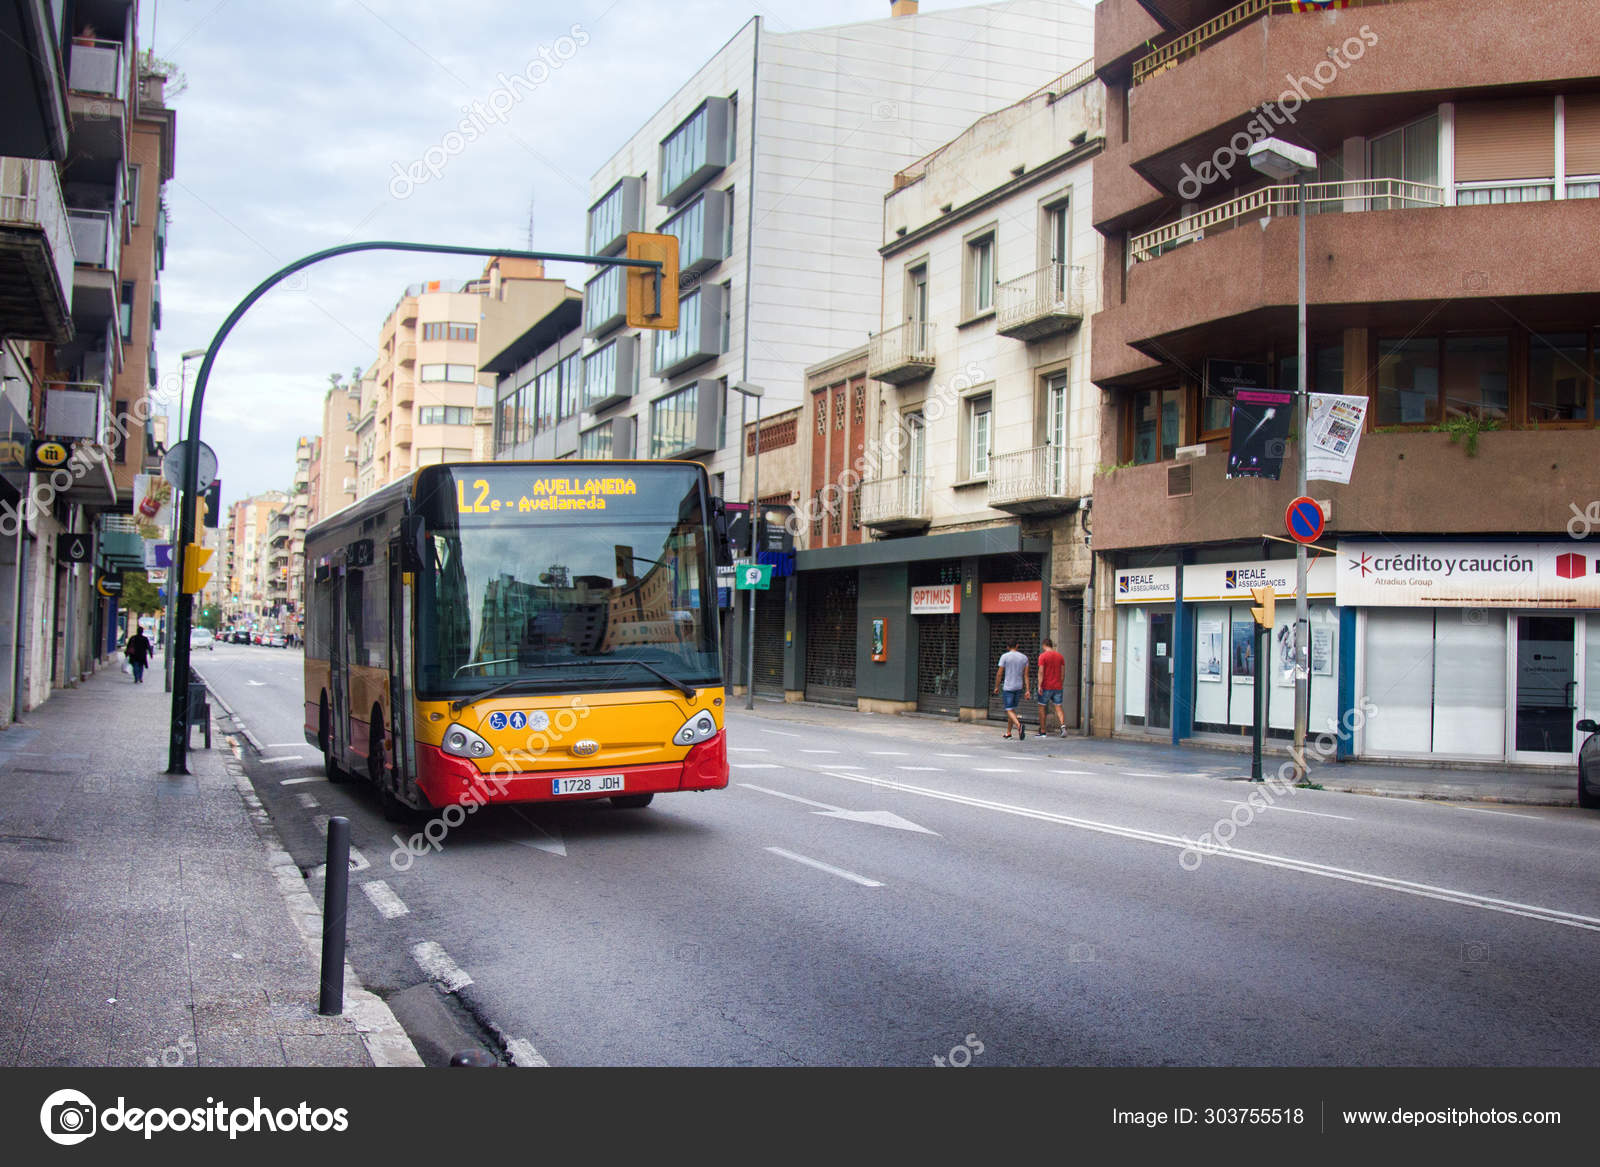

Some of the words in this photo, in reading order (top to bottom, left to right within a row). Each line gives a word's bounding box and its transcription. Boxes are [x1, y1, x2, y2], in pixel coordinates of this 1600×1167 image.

[533, 478, 637, 495] AVELLANEDA
[518, 495, 606, 512] Avellaneda
[1374, 554, 1442, 572] crédito
[1444, 558, 1456, 576] y
[1458, 554, 1534, 572] caución
[1130, 574, 1154, 585] REALE
[1238, 568, 1267, 579] REALE
[1130, 583, 1170, 592] ASSEGURANCES
[1238, 578, 1286, 588] ASSEGURANCES
[1374, 577, 1407, 585] Atradius
[1409, 577, 1433, 587] Group
[913, 589, 951, 605] OPTIMUS
[563, 779, 592, 792] 1728
[599, 777, 620, 790] JDH
